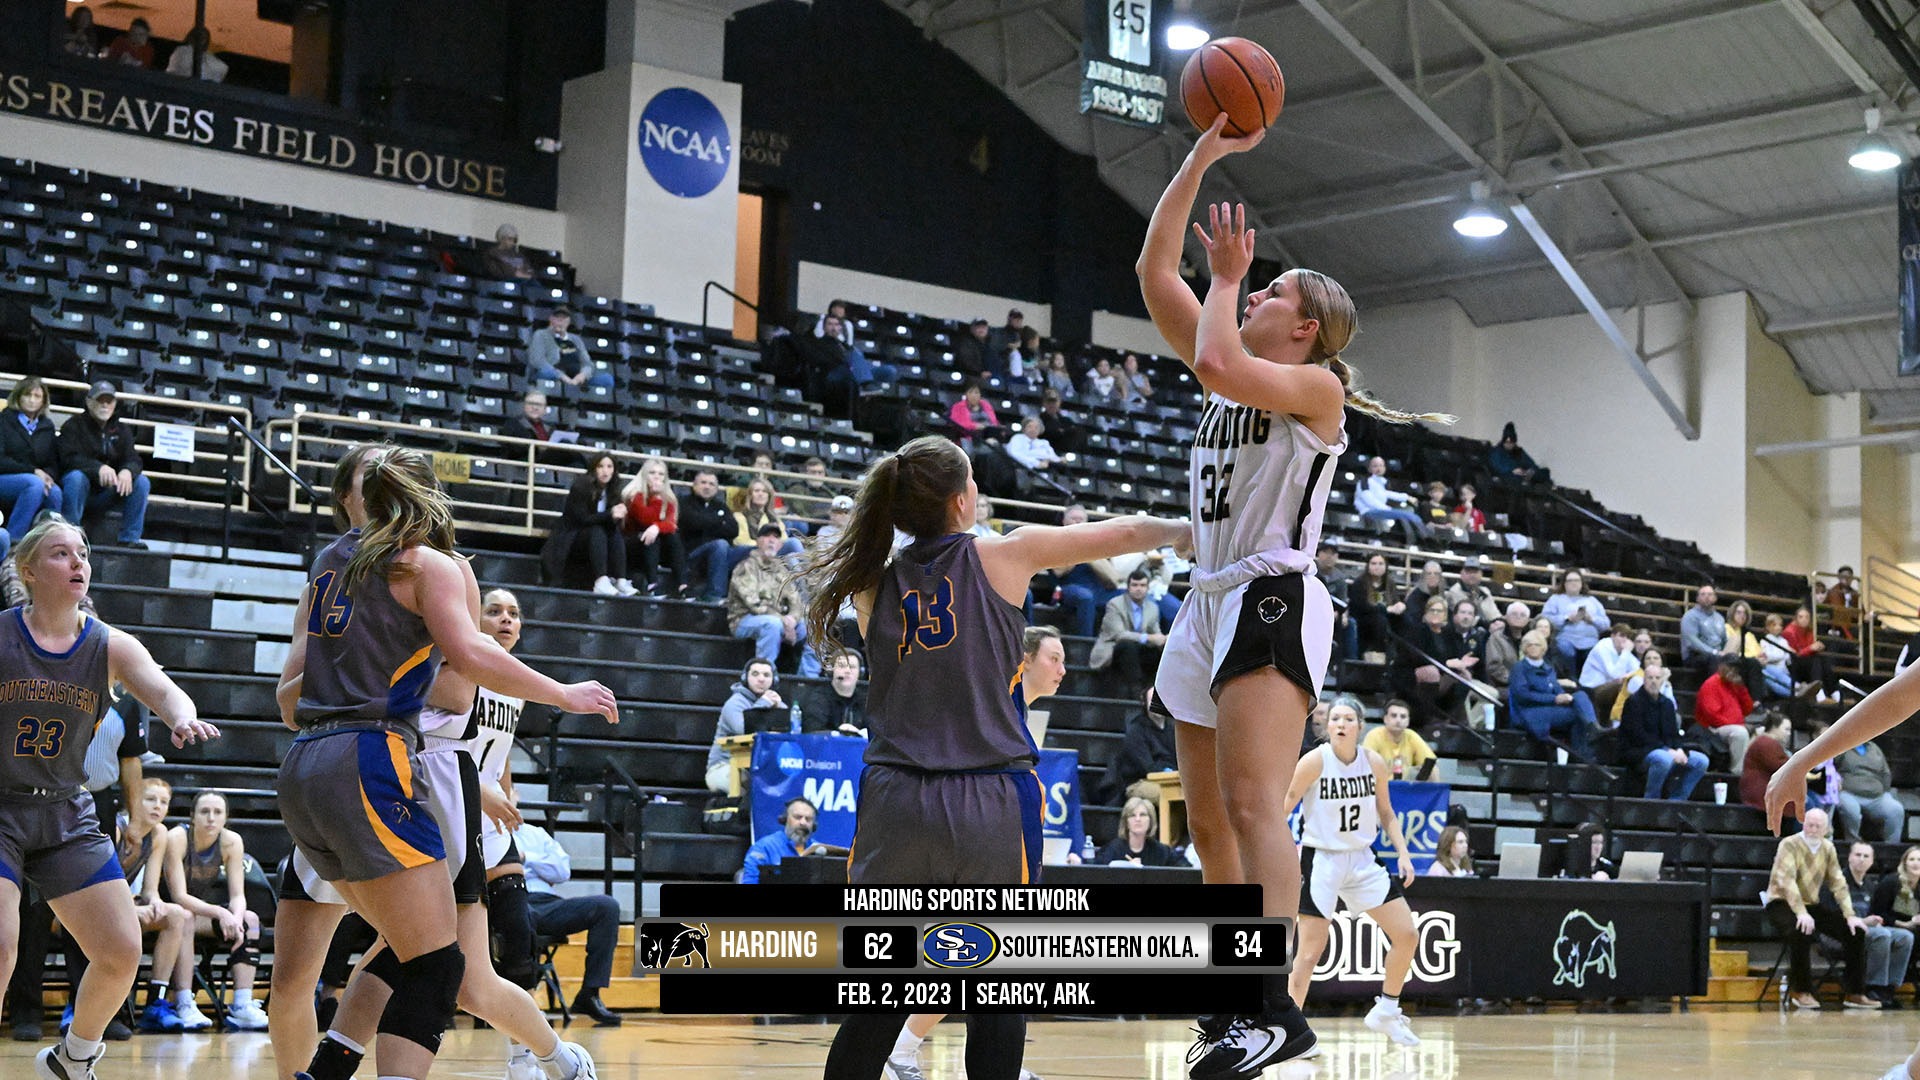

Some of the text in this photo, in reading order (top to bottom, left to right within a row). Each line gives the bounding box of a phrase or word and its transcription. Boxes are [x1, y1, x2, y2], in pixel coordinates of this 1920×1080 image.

[1112, 0, 1146, 34] 45
[0, 72, 507, 196] S-REAVES FIELD HOUSE
[643, 119, 726, 164] NCAA
[741, 145, 782, 167] OOM
[1200, 463, 1235, 522] 32
[308, 570, 356, 638] 15
[898, 575, 958, 662] 13
[14, 716, 67, 759] 23
[478, 738, 496, 772] 1
[805, 758, 837, 770] Division
[1319, 775, 1376, 799] HARDING
[1338, 804, 1361, 832] 12
